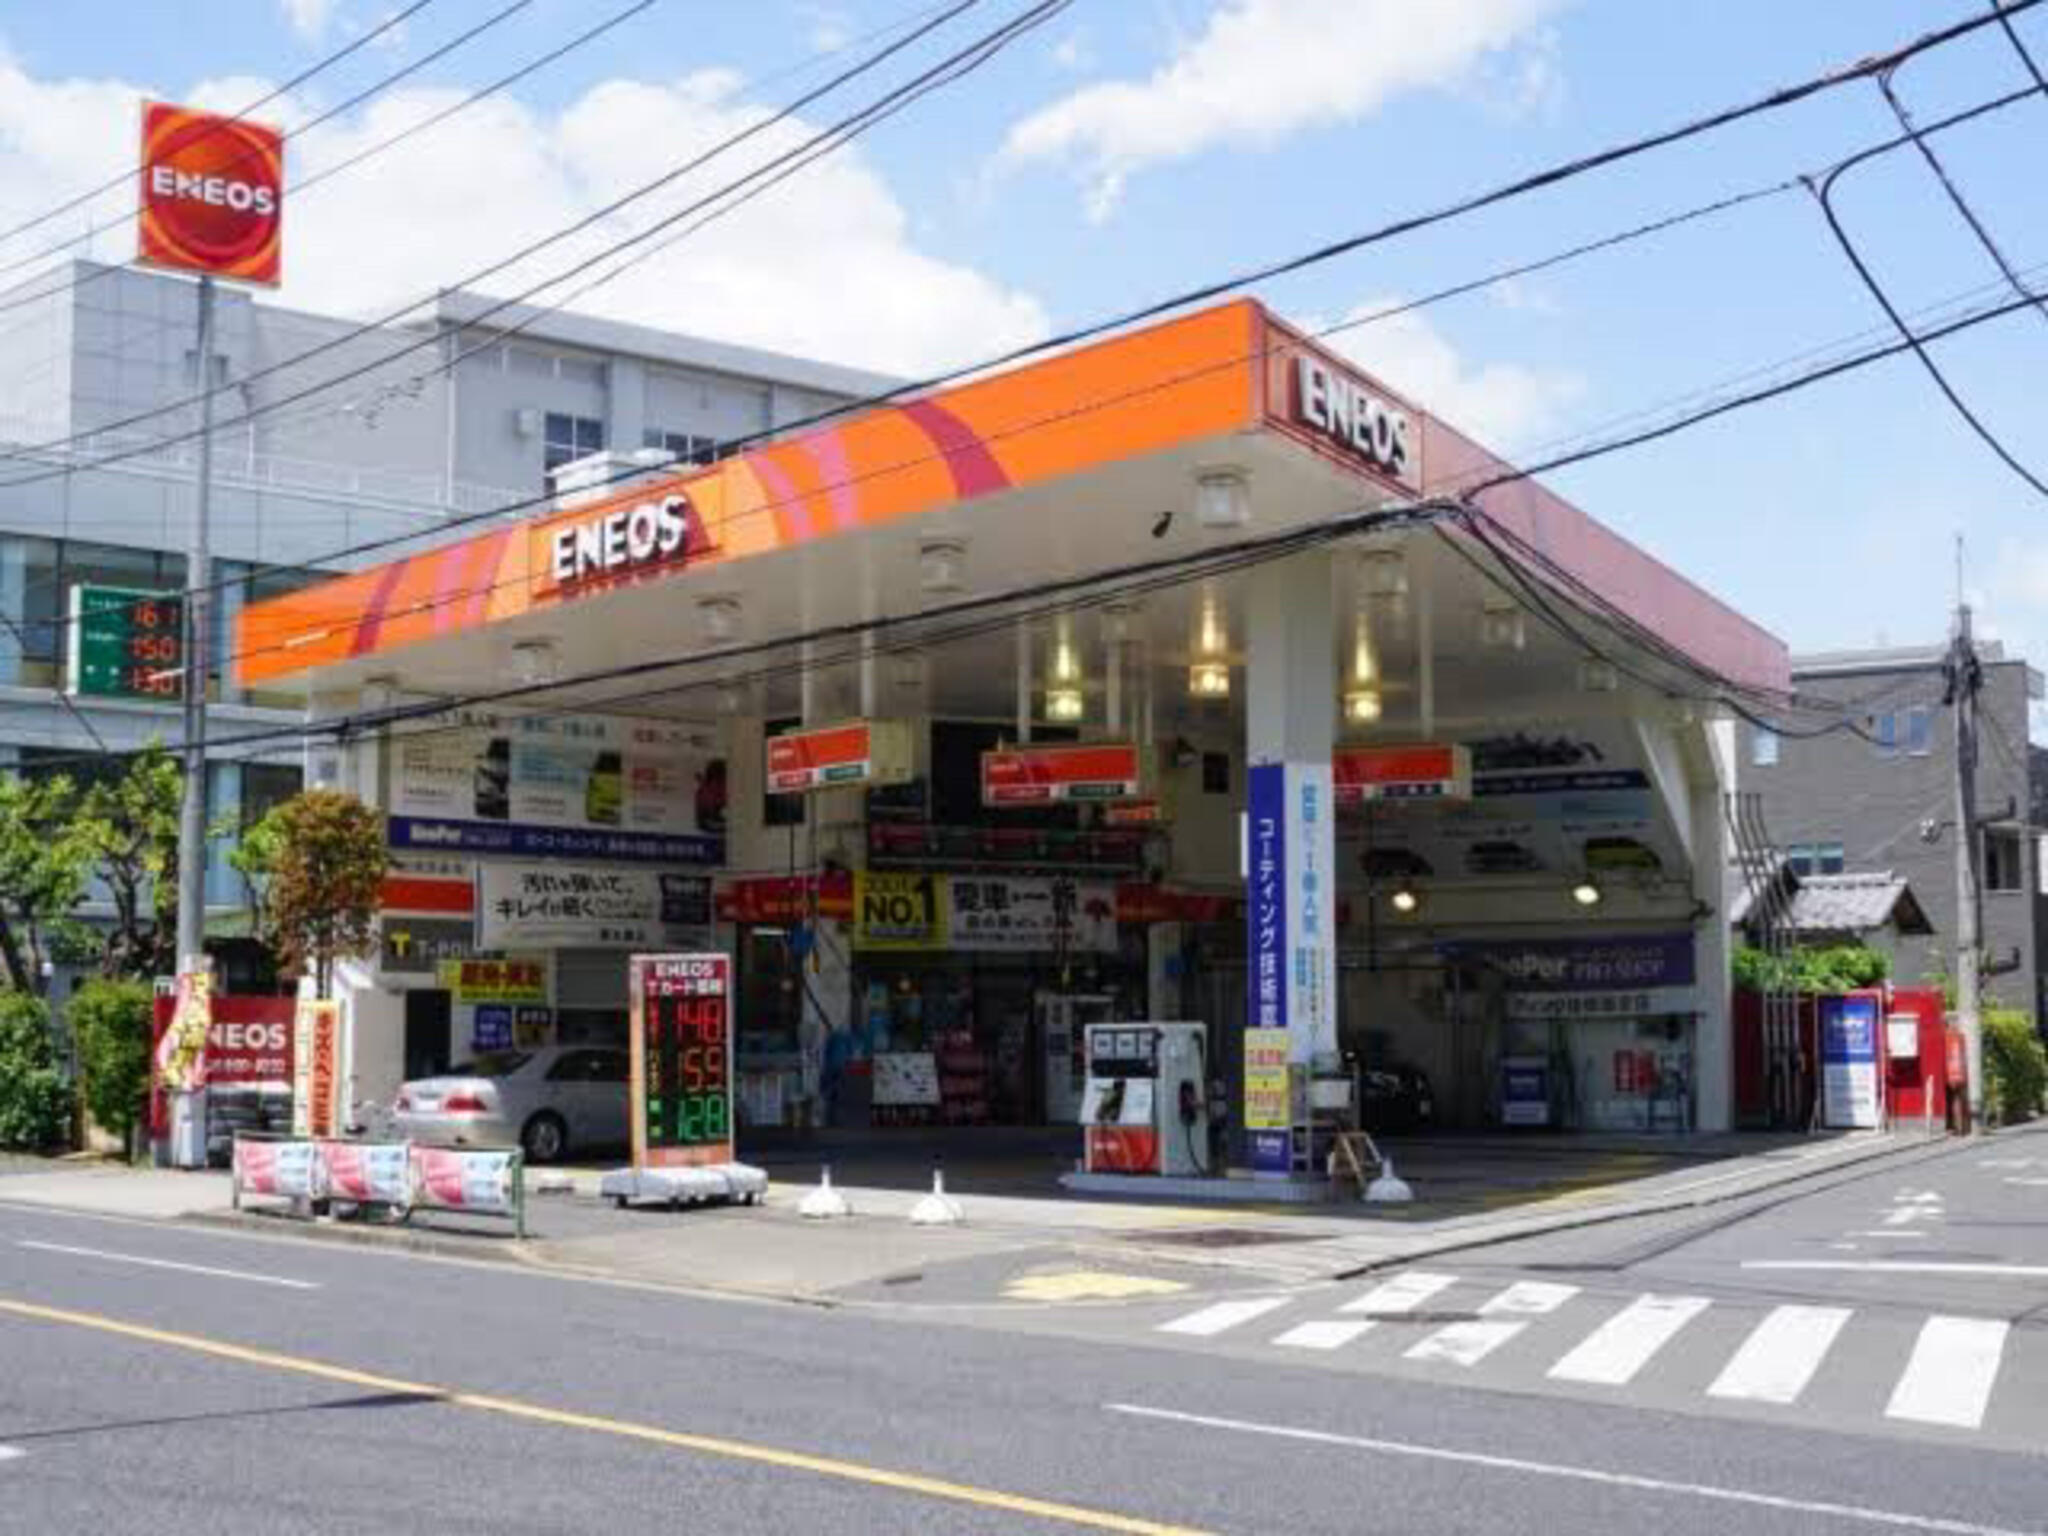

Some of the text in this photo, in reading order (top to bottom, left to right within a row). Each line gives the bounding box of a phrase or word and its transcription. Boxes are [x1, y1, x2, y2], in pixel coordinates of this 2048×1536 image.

[152, 165, 275, 216] ENEOS
[1300, 357, 1407, 471] ENEOS
[552, 494, 688, 578] ENEOS
[863, 877, 936, 925] NO.1
[655, 962, 715, 978] ENEOS
[207, 1021, 287, 1051] NEOS
[677, 999, 723, 1043] 148
[677, 1096, 726, 1141] 128
